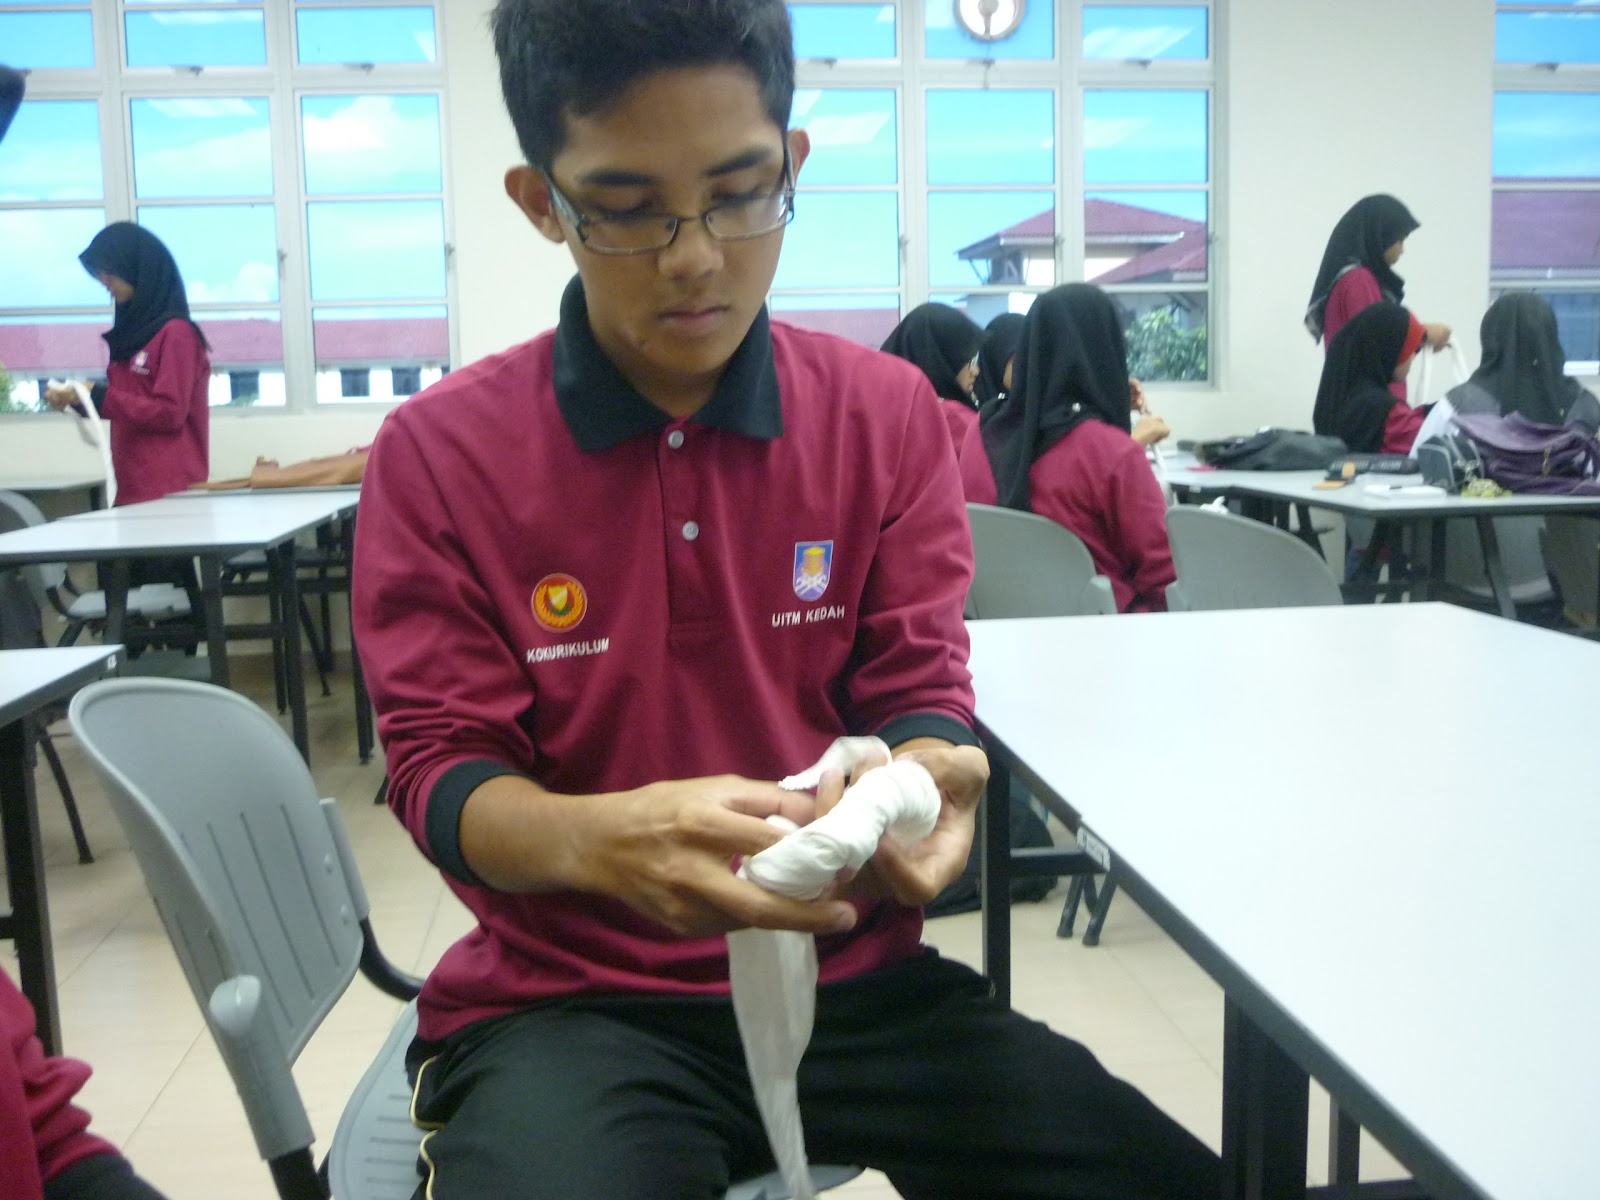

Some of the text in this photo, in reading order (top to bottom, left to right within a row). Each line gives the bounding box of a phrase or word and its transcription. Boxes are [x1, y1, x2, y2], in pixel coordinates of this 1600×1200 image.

[771, 604, 845, 628] UITM KEDAH
[526, 636, 610, 664] KOKURIKULUM
